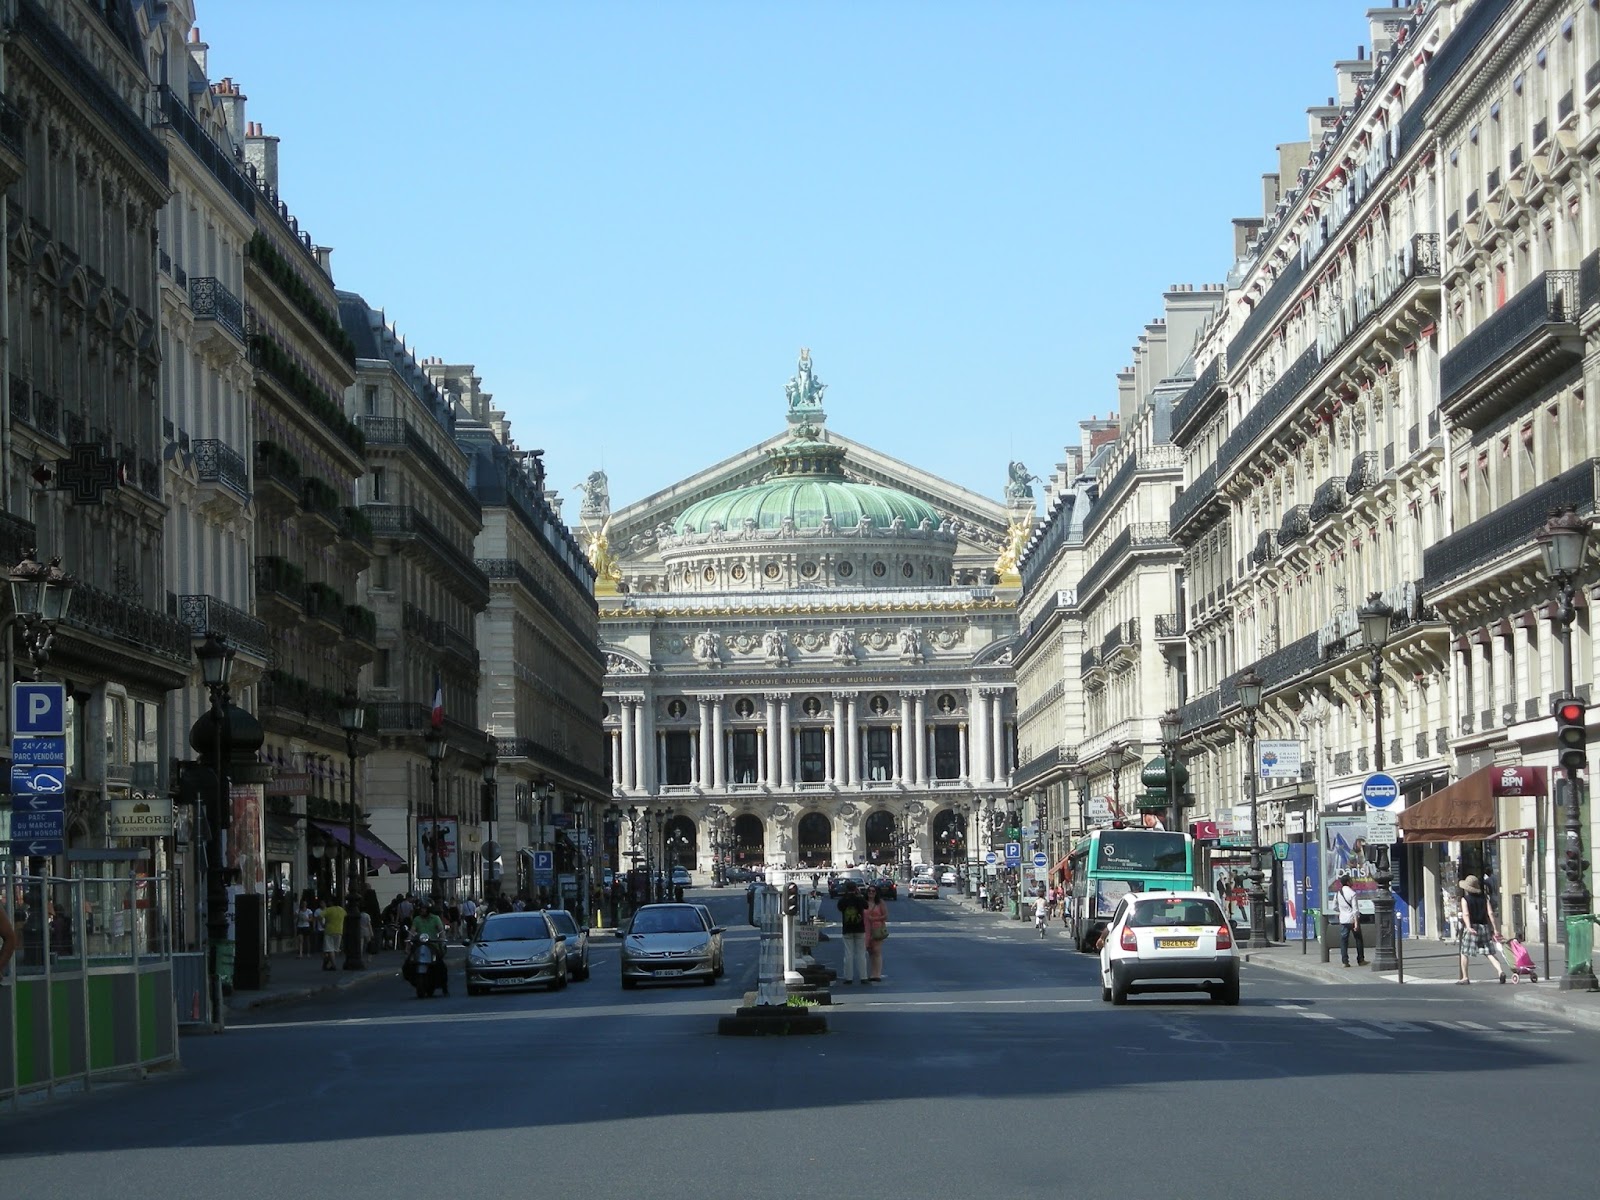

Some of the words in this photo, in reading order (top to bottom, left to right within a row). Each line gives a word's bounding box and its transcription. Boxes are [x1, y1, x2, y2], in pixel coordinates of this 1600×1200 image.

[29, 693, 51, 724] P
[14, 752, 31, 760] PARC
[33, 751, 64, 760] VENDÔME
[1501, 776, 1523, 787] BPN
[112, 815, 171, 825] ALLEGRE
[17, 822, 27, 830] DU
[1010, 846, 1017, 855] P
[539, 855, 547, 866] P
